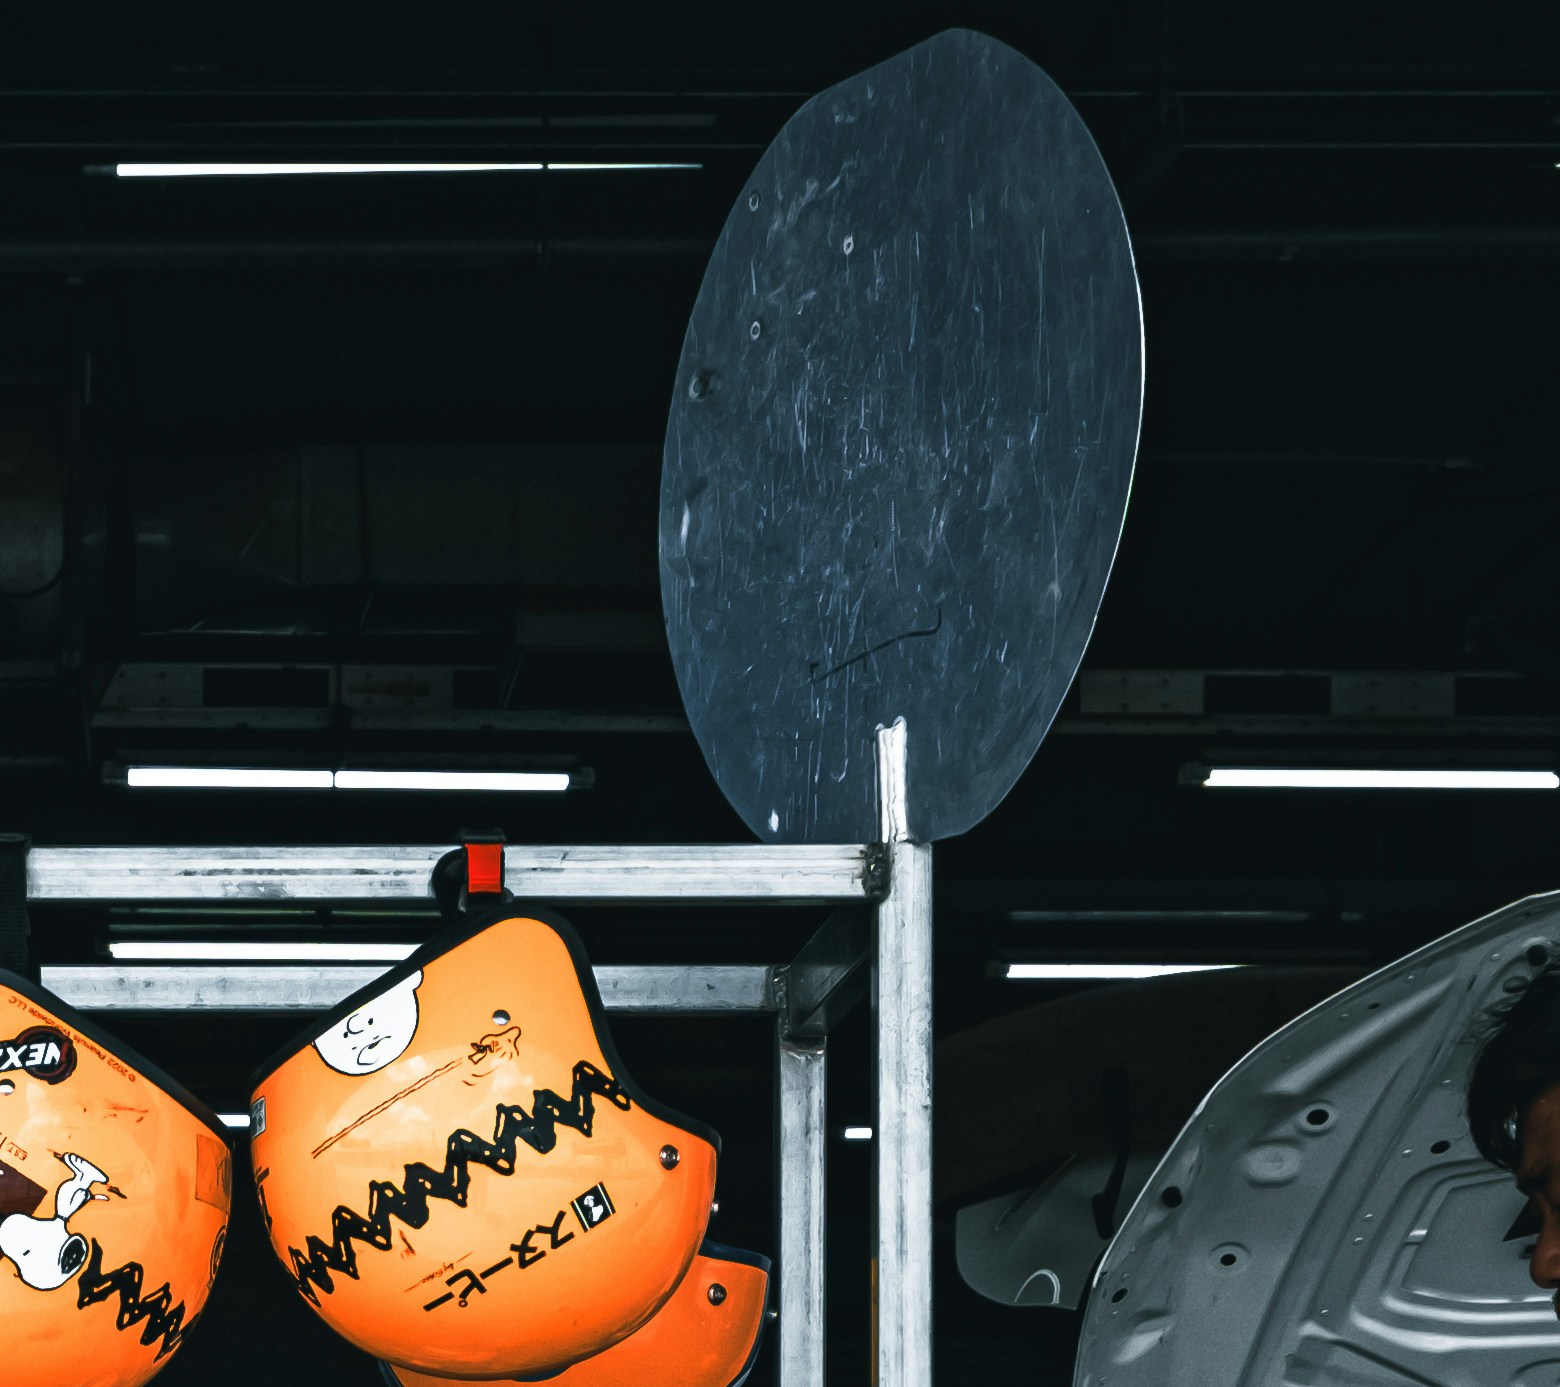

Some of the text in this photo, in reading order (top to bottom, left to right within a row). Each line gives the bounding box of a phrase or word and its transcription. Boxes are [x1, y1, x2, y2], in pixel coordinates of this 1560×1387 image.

[422, 1210, 575, 1312] スヌーピー
